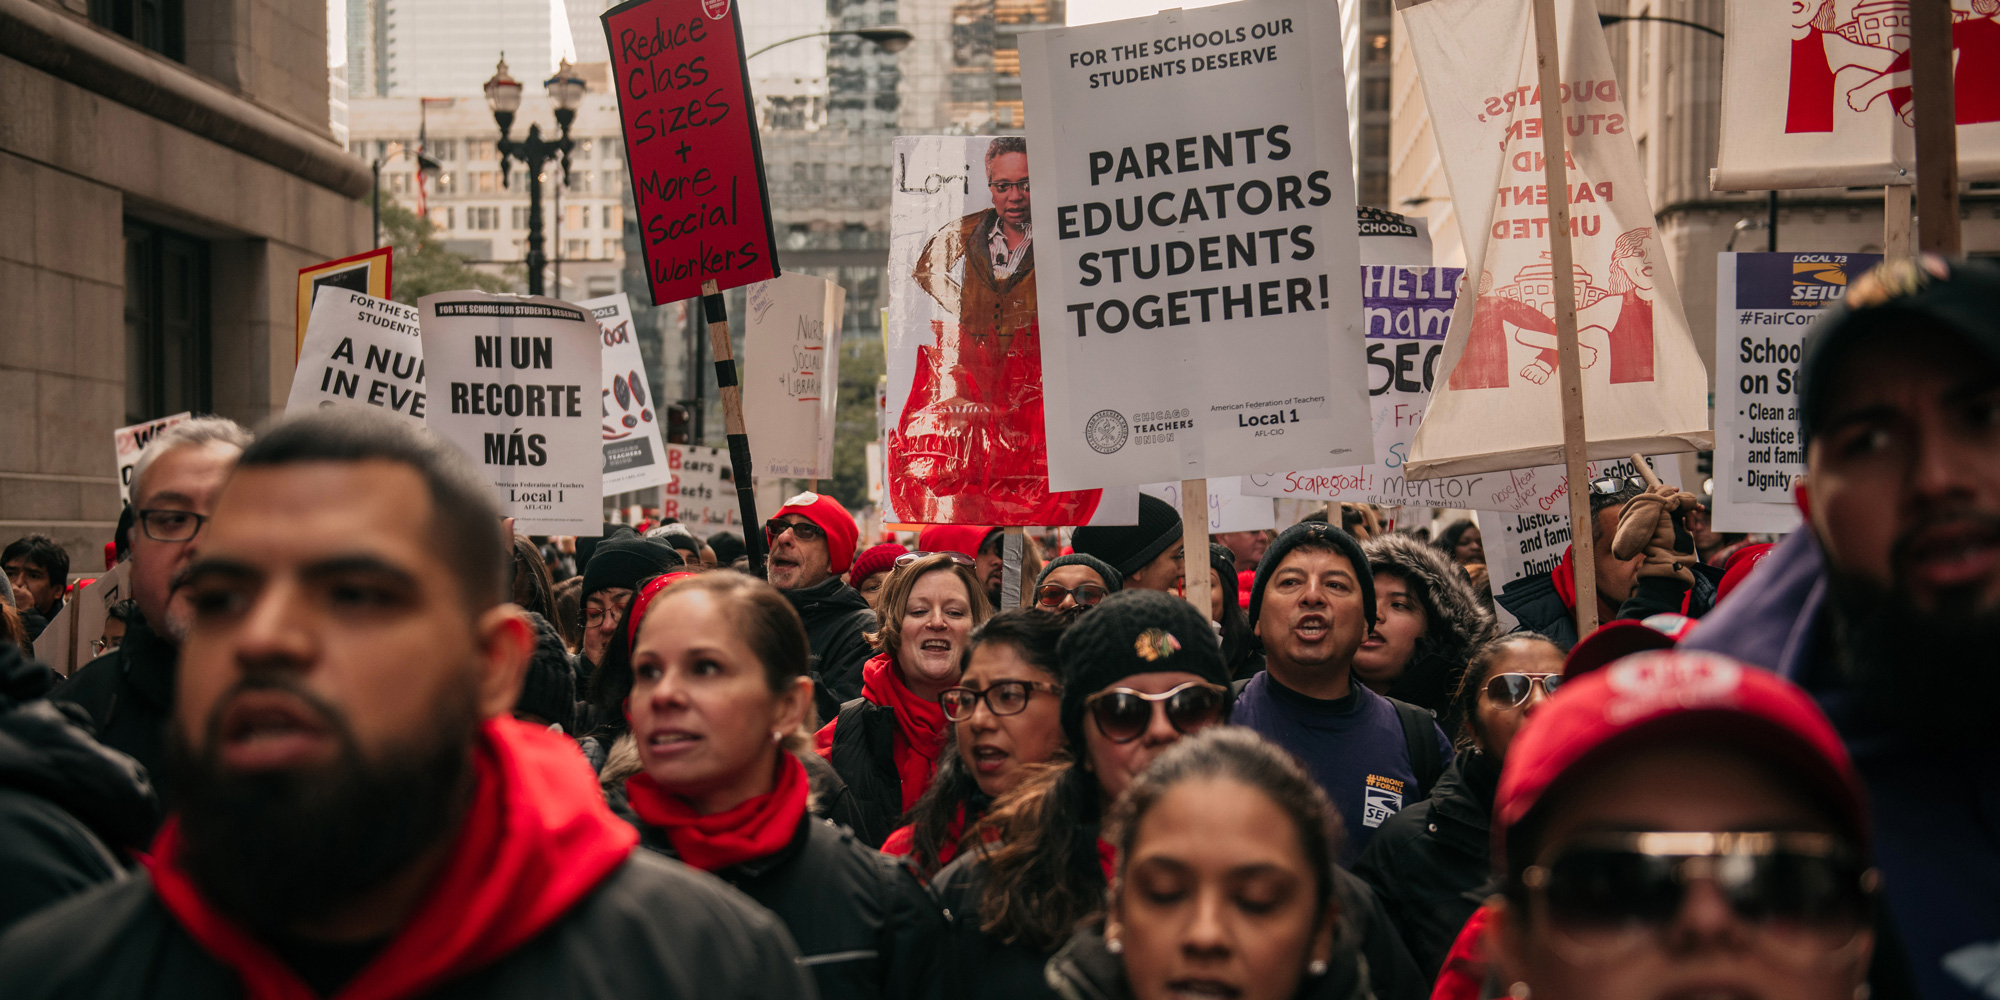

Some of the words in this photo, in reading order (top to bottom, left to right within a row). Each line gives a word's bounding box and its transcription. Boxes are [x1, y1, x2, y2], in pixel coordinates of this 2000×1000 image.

[620, 17, 707, 64] Reduce
[1070, 50, 1108, 68] FOR
[1112, 42, 1149, 62] THE
[1153, 27, 1246, 55] SCHOOLS
[1251, 18, 1294, 39] OUR
[628, 56, 709, 100] Class
[1089, 59, 1186, 89] STUDENTS
[1191, 45, 1277, 73] DESERVE
[634, 88, 730, 146] Sizes
[1089, 125, 1291, 186] PARENTS
[900, 153, 969, 194] Lori
[640, 168, 717, 205] More
[648, 176, 737, 245] Social
[1057, 170, 1331, 240] EDUCATORS
[1078, 225, 1315, 287] STUDENTS
[1793, 255, 1831, 263] LOCAL
[1834, 255, 1848, 263] 73
[1790, 286, 1847, 300] SEIU
[350, 294, 374, 309] FOR
[378, 301, 401, 317] THE
[439, 305, 453, 314] FOR
[454, 305, 468, 314] THE
[469, 305, 499, 314] SCHOOLS
[500, 305, 514, 314] OUR
[515, 306, 551, 316] STUDENTS
[552, 309, 581, 320] DESERVE
[1067, 274, 1329, 337] TOGETHER!
[358, 311, 420, 337] STUDENTS
[331, 337, 354, 365] A
[475, 335, 502, 368] NI
[510, 336, 552, 369] UN
[321, 366, 360, 399] IN
[1740, 374, 1769, 395] on
[451, 382, 582, 418] RECORTE
[1210, 403, 1244, 412] American
[1245, 400, 1283, 410] Federation
[1284, 398, 1292, 407] of
[1293, 396, 1325, 405] Teachers
[1133, 408, 1190, 423] CHICAGO
[1238, 410, 1284, 428] Local
[1287, 409, 1300, 423] 1
[1749, 403, 1784, 421] Clean
[1134, 418, 1194, 434] TEACHERS
[1254, 428, 1284, 438] AFL-CIO
[1748, 427, 1794, 444] Justice
[484, 428, 547, 466] MÁS
[1134, 432, 1175, 446] UNION
[609, 450, 642, 460] TEACHERS
[668, 448, 714, 473] Bears
[1748, 446, 1771, 464] and
[1603, 457, 1653, 478] schos
[494, 481, 518, 489] American
[1283, 466, 1373, 497] Scapegoat!
[1747, 470, 1791, 492] Dignity
[510, 489, 552, 503] Local
[557, 490, 564, 503] 1
[1412, 497, 1421, 506] in
[1510, 483, 1537, 511] wiper
[1520, 531, 1543, 554] and
[1366, 808, 1394, 820] SEI
